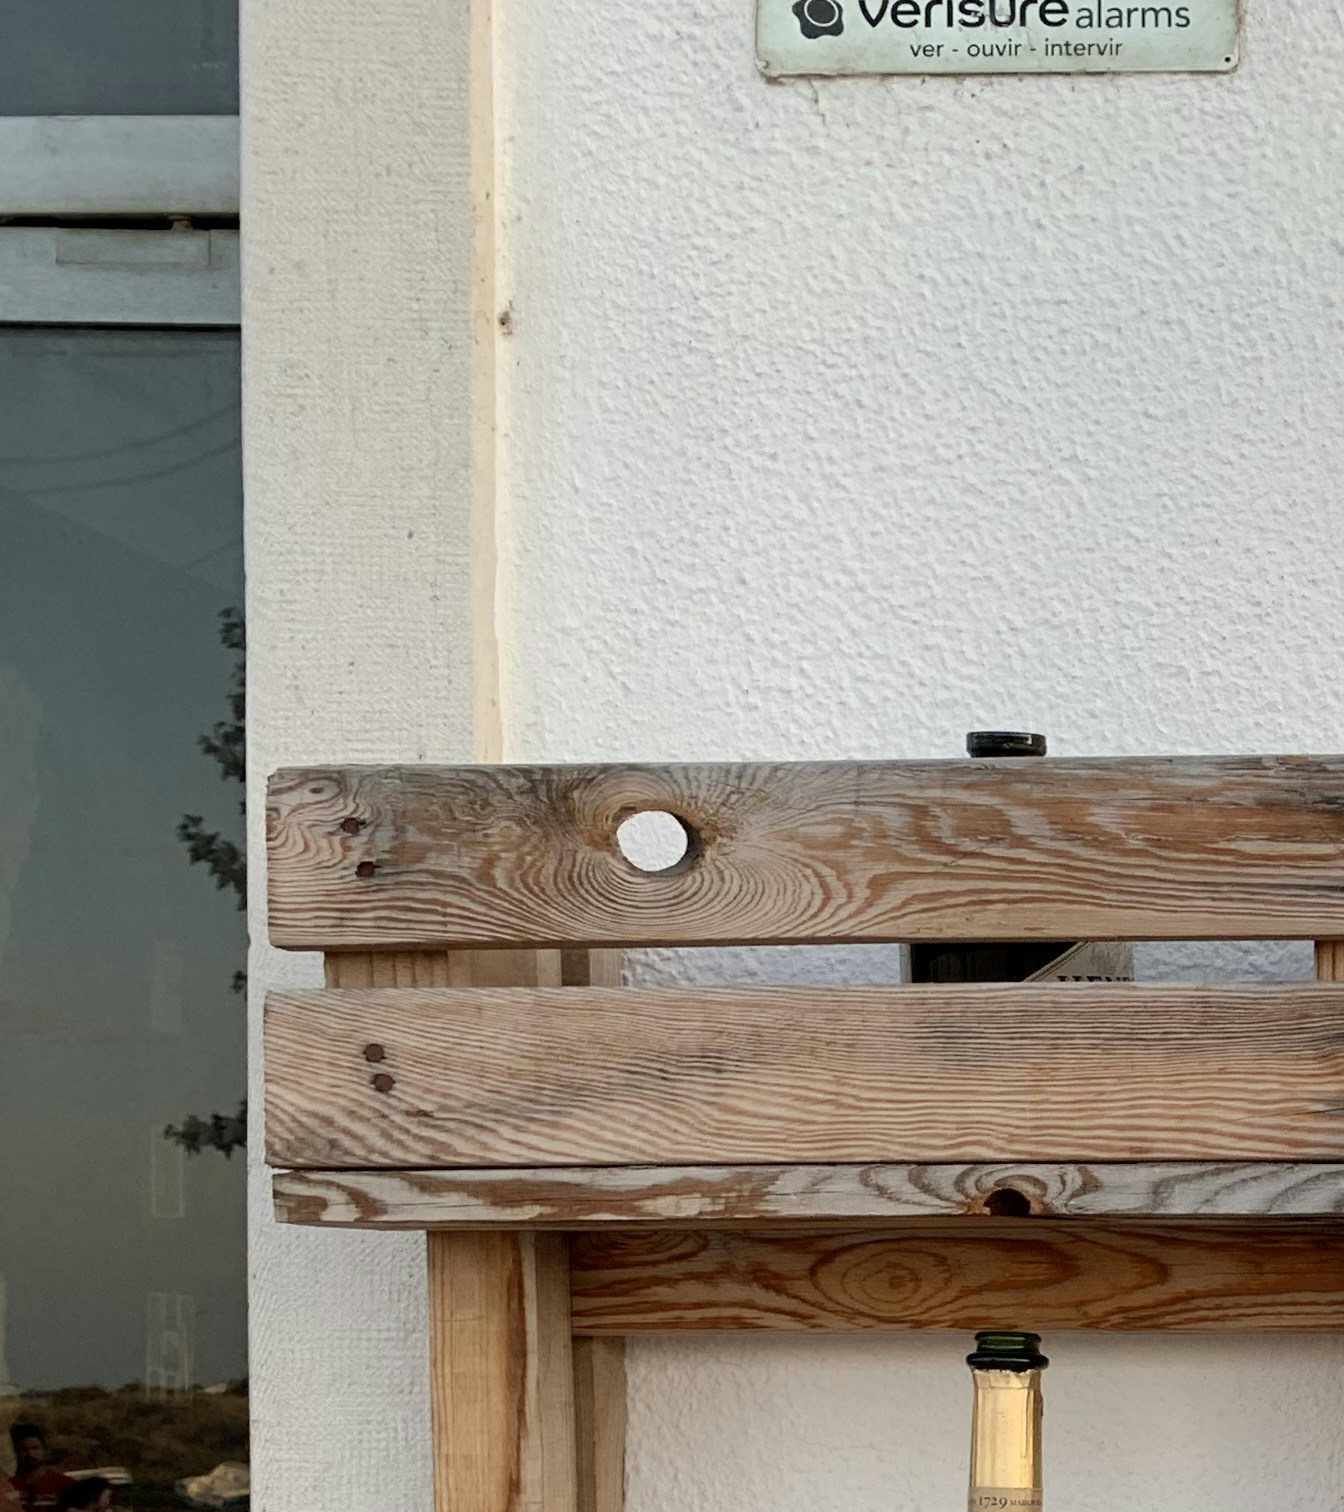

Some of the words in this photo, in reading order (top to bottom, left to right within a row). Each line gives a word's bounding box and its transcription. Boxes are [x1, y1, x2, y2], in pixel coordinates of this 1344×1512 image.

[1076, 0, 1191, 29] alarms
[909, 42, 944, 58] ver
[967, 39, 1022, 57] ouvir
[1044, 39, 1123, 56] intervir
[979, 1496, 1008, 1509] 1729
